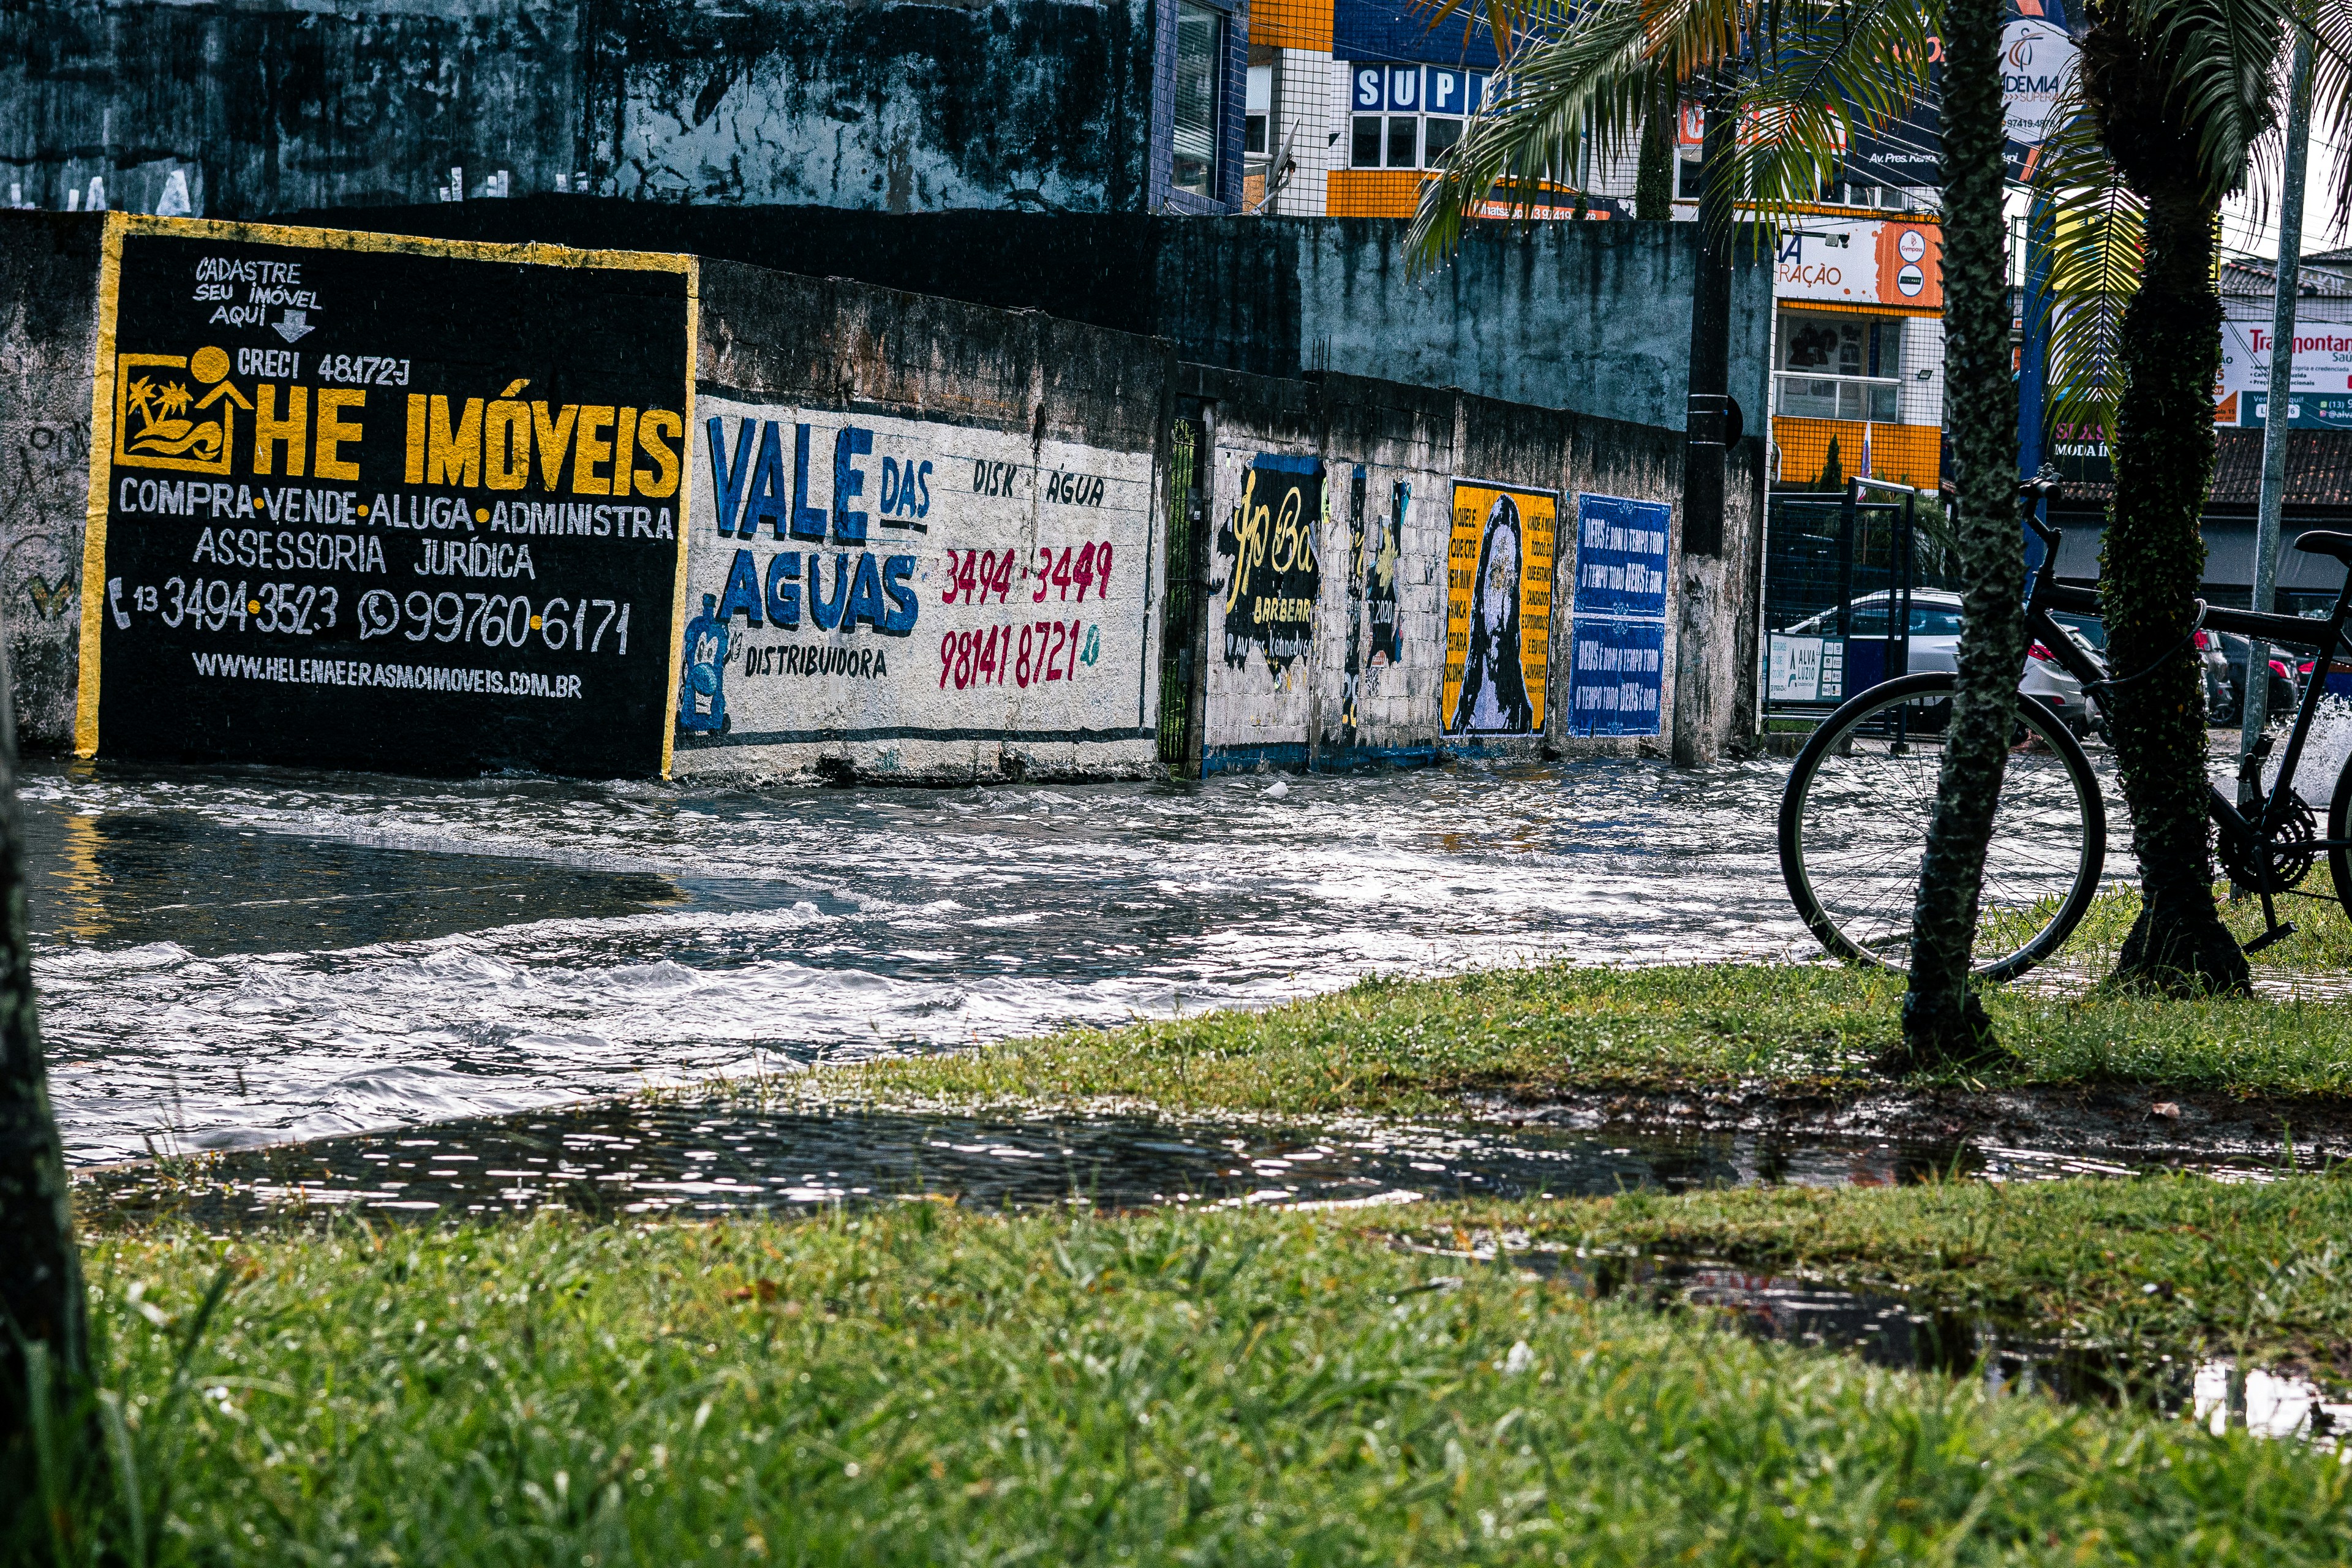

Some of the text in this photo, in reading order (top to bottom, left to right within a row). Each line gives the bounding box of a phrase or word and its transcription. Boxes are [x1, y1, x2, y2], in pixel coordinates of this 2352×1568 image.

[1885, 153, 1907, 163] Pres.
[196, 257, 301, 284] CADASTRE
[192, 284, 233, 301] SEU
[238, 347, 300, 379] CRECI
[254, 379, 682, 497] HE IMÓVEIS
[2055, 444, 2096, 456] MODA
[707, 416, 933, 546] VALE DAS
[974, 460, 1105, 508] DISK ÁGUA
[1453, 508, 1477, 528] AQUELE
[1450, 538, 1463, 558] QUE
[1531, 540, 1545, 558] TODOS
[1585, 518, 1664, 555] DEUS É BOM O TEMPO TODO
[192, 527, 536, 579] ASSESSORIA JURÍDICA
[1527, 565, 1536, 581] QUE
[1582, 563, 1662, 594] O TEMPO TODO DEUS É BOM
[134, 586, 158, 612] 13
[716, 548, 919, 637] AGUAS
[745, 645, 887, 679] DISTRIBUIDORA
[1578, 641, 1658, 672] DEUS É BOM O TEMPO TODO
[1799, 649, 1815, 665] ALVA
[1798, 667, 1815, 680] LUZIO
[1576, 682, 1656, 712] O TEMPO TODO DEUS É BOM
